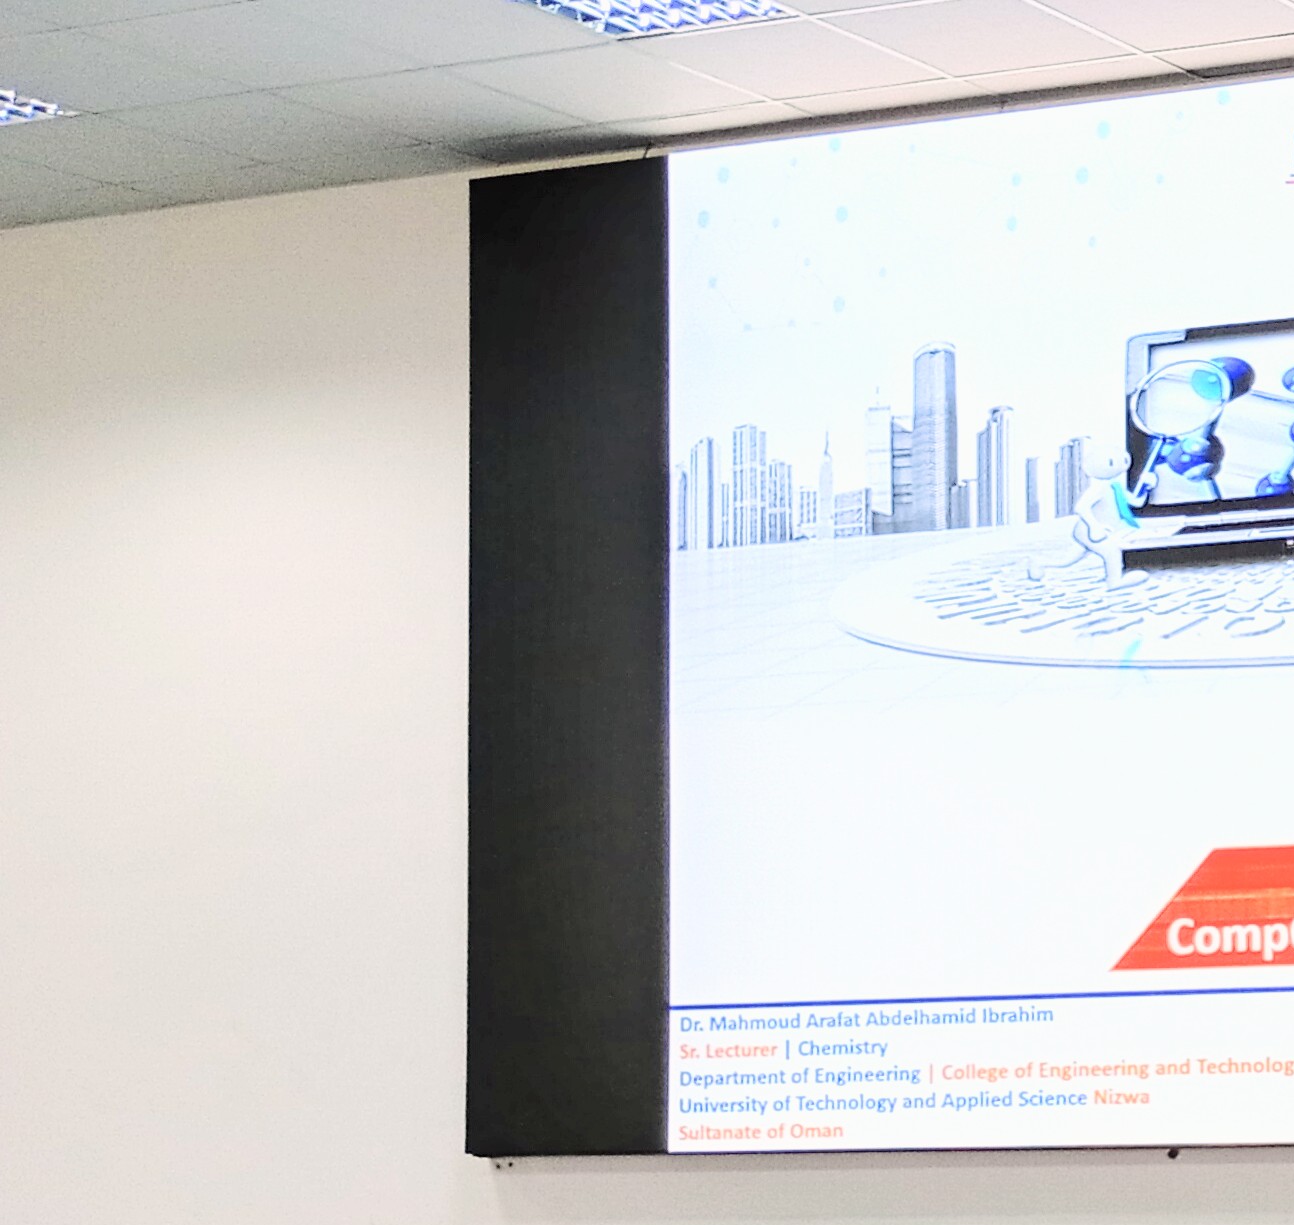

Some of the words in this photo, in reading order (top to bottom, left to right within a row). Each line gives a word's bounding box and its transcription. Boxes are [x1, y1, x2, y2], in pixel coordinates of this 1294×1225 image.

[680, 1016, 703, 1032] Dr.
[709, 1013, 800, 1031] Mahmoud
[806, 1012, 860, 1028] Arafat
[865, 1008, 976, 1026] Abdelhamid
[982, 1006, 1054, 1023] Ibrahim
[680, 1044, 700, 1059] Sr.
[706, 1044, 777, 1058] Lecturer
[798, 1039, 888, 1057] Chemistry
[679, 1070, 786, 1089] Department
[791, 1067, 809, 1084] of
[815, 1065, 921, 1085] Engineering
[942, 1063, 1008, 1082] College
[1014, 1062, 1033, 1078] of
[1039, 1059, 1149, 1080] Engineering
[1155, 1058, 1190, 1075] and
[679, 1097, 767, 1115] University
[773, 1096, 791, 1111] of
[796, 1094, 897, 1112] Technology
[902, 1092, 936, 1108] and
[941, 1090, 1013, 1111] Applied
[1018, 1089, 1088, 1107] Science
[1094, 1089, 1150, 1104] Nizwa
[679, 1125, 761, 1140] Sultanate
[767, 1123, 785, 1139] of
[790, 1123, 844, 1138] Oman
